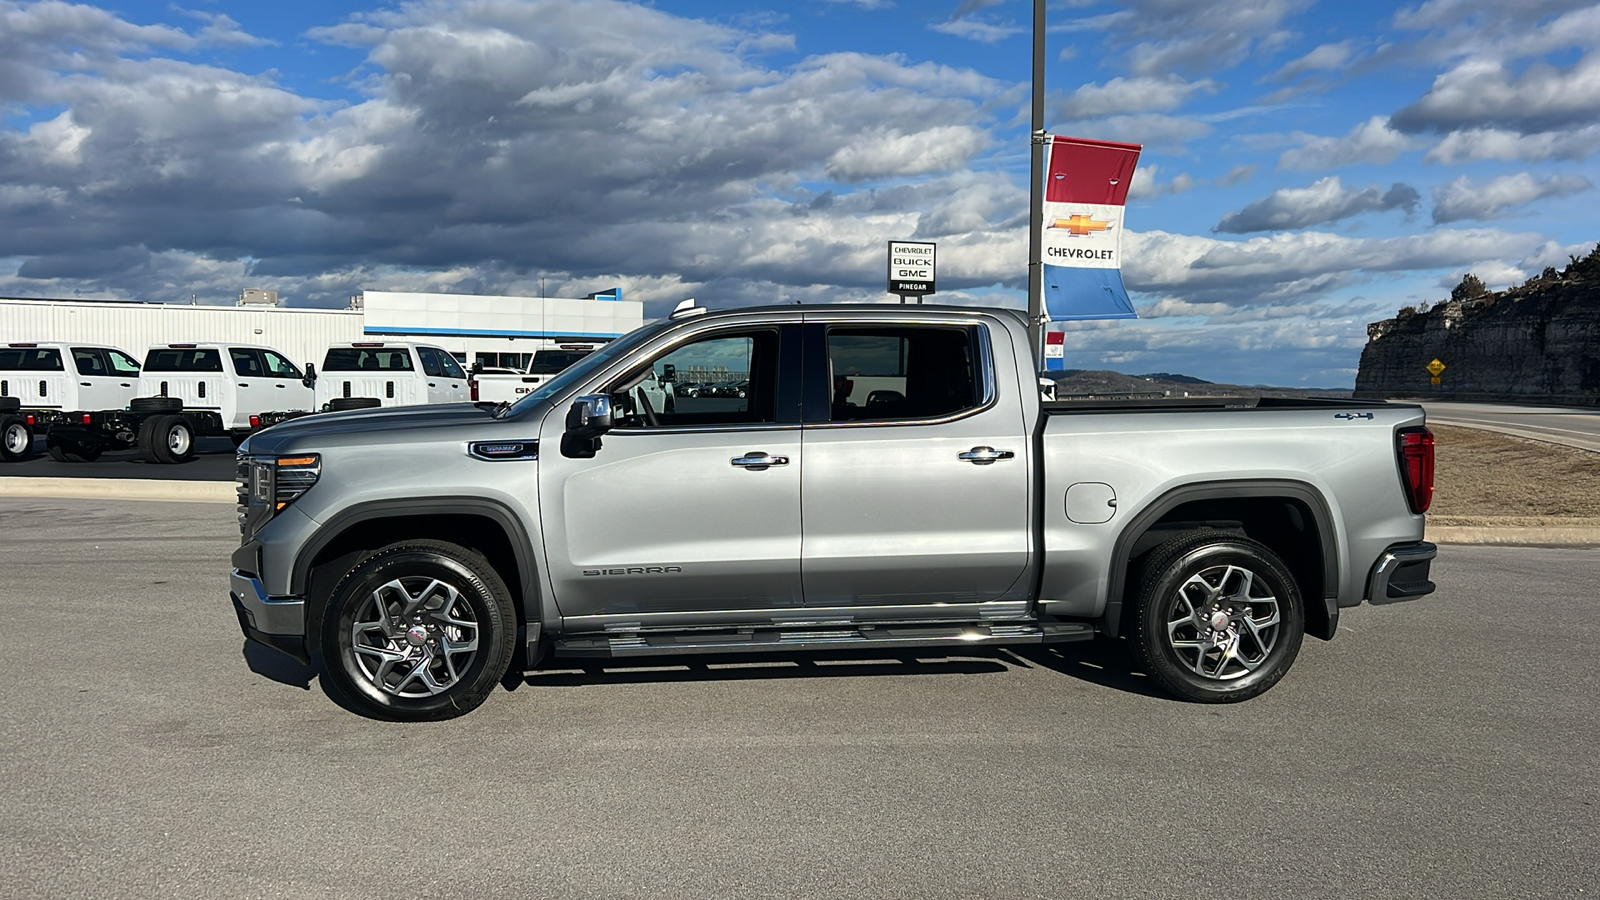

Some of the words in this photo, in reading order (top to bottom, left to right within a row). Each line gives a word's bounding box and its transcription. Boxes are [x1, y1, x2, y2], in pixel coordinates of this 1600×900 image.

[1047, 246, 1113, 260] CHEVROLET
[893, 258, 932, 266] BUICK
[899, 269, 927, 277] GMC
[582, 565, 682, 577] SIERRA
